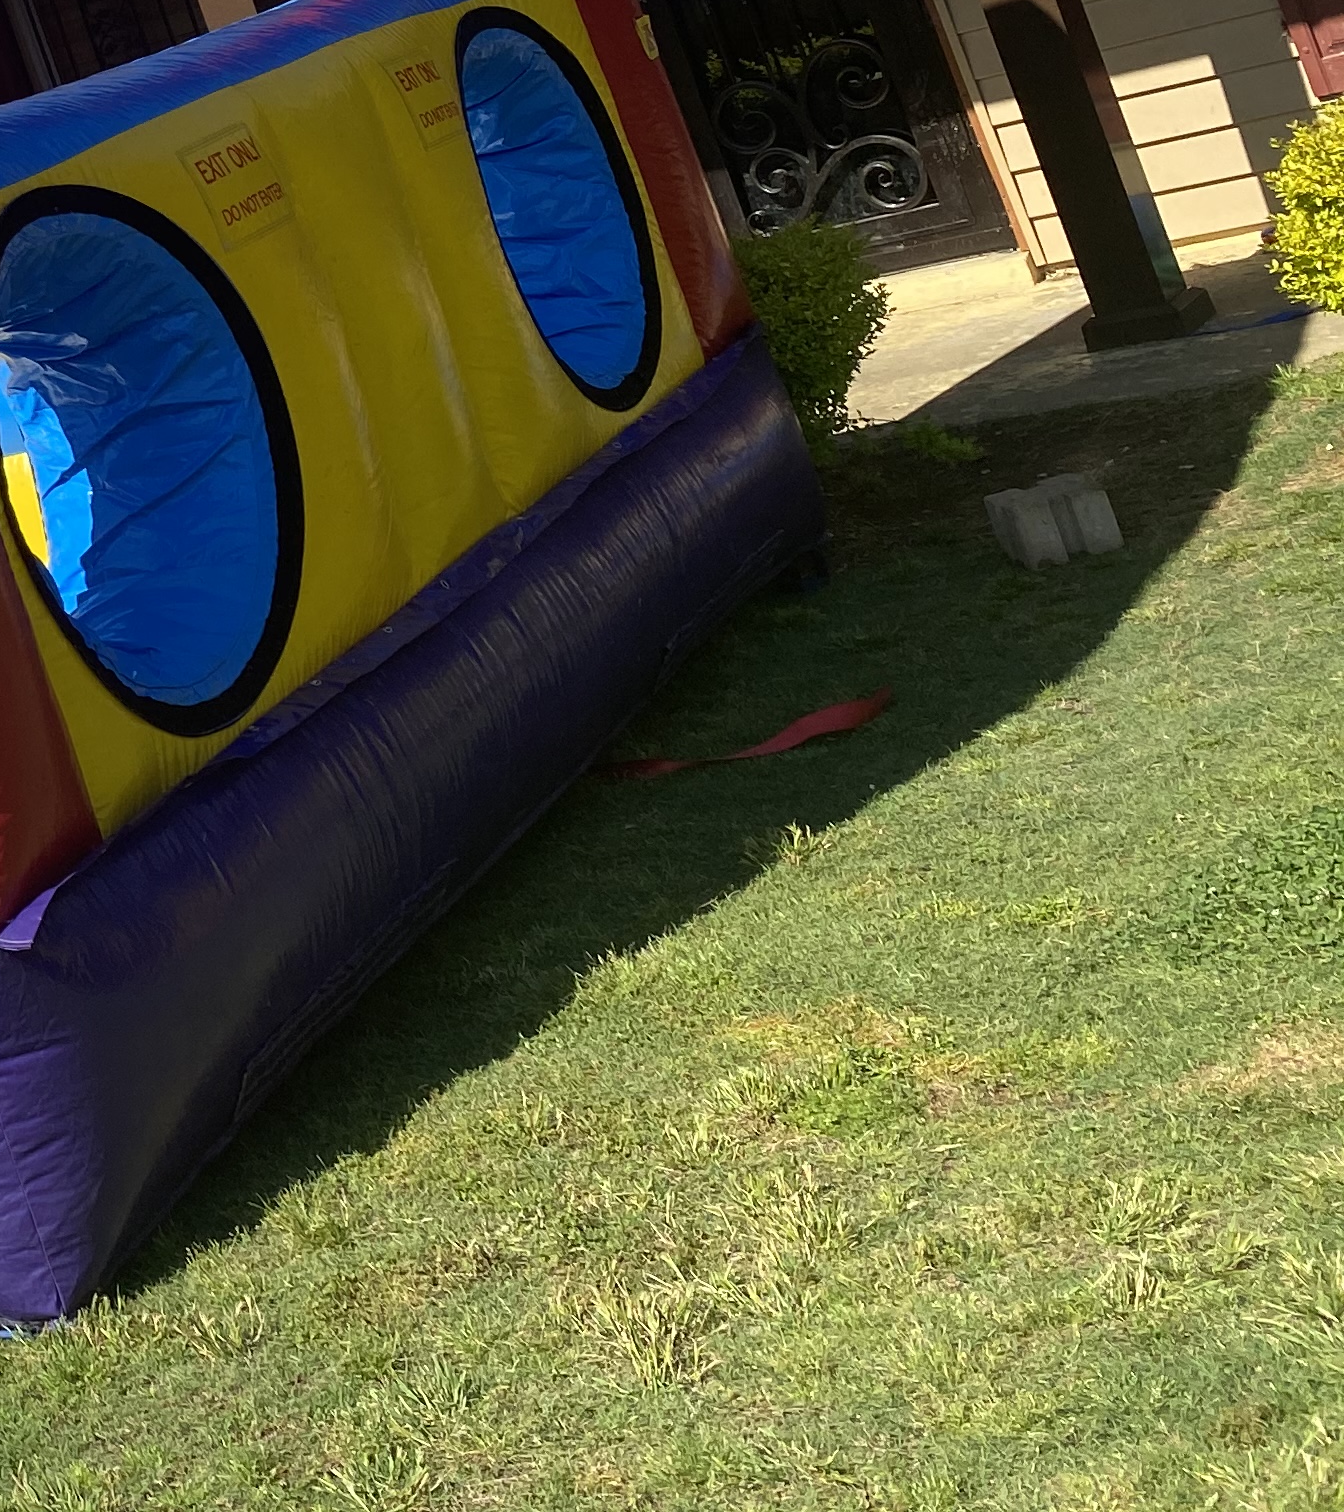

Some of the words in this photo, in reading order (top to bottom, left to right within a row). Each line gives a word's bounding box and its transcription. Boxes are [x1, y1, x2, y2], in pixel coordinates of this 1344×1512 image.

[395, 67, 422, 91] EXIT
[195, 152, 231, 184] EXIT
[226, 136, 261, 168] ONLY
[222, 204, 241, 226] DO
[239, 193, 262, 217] NOT
[258, 182, 284, 206] ENTER
